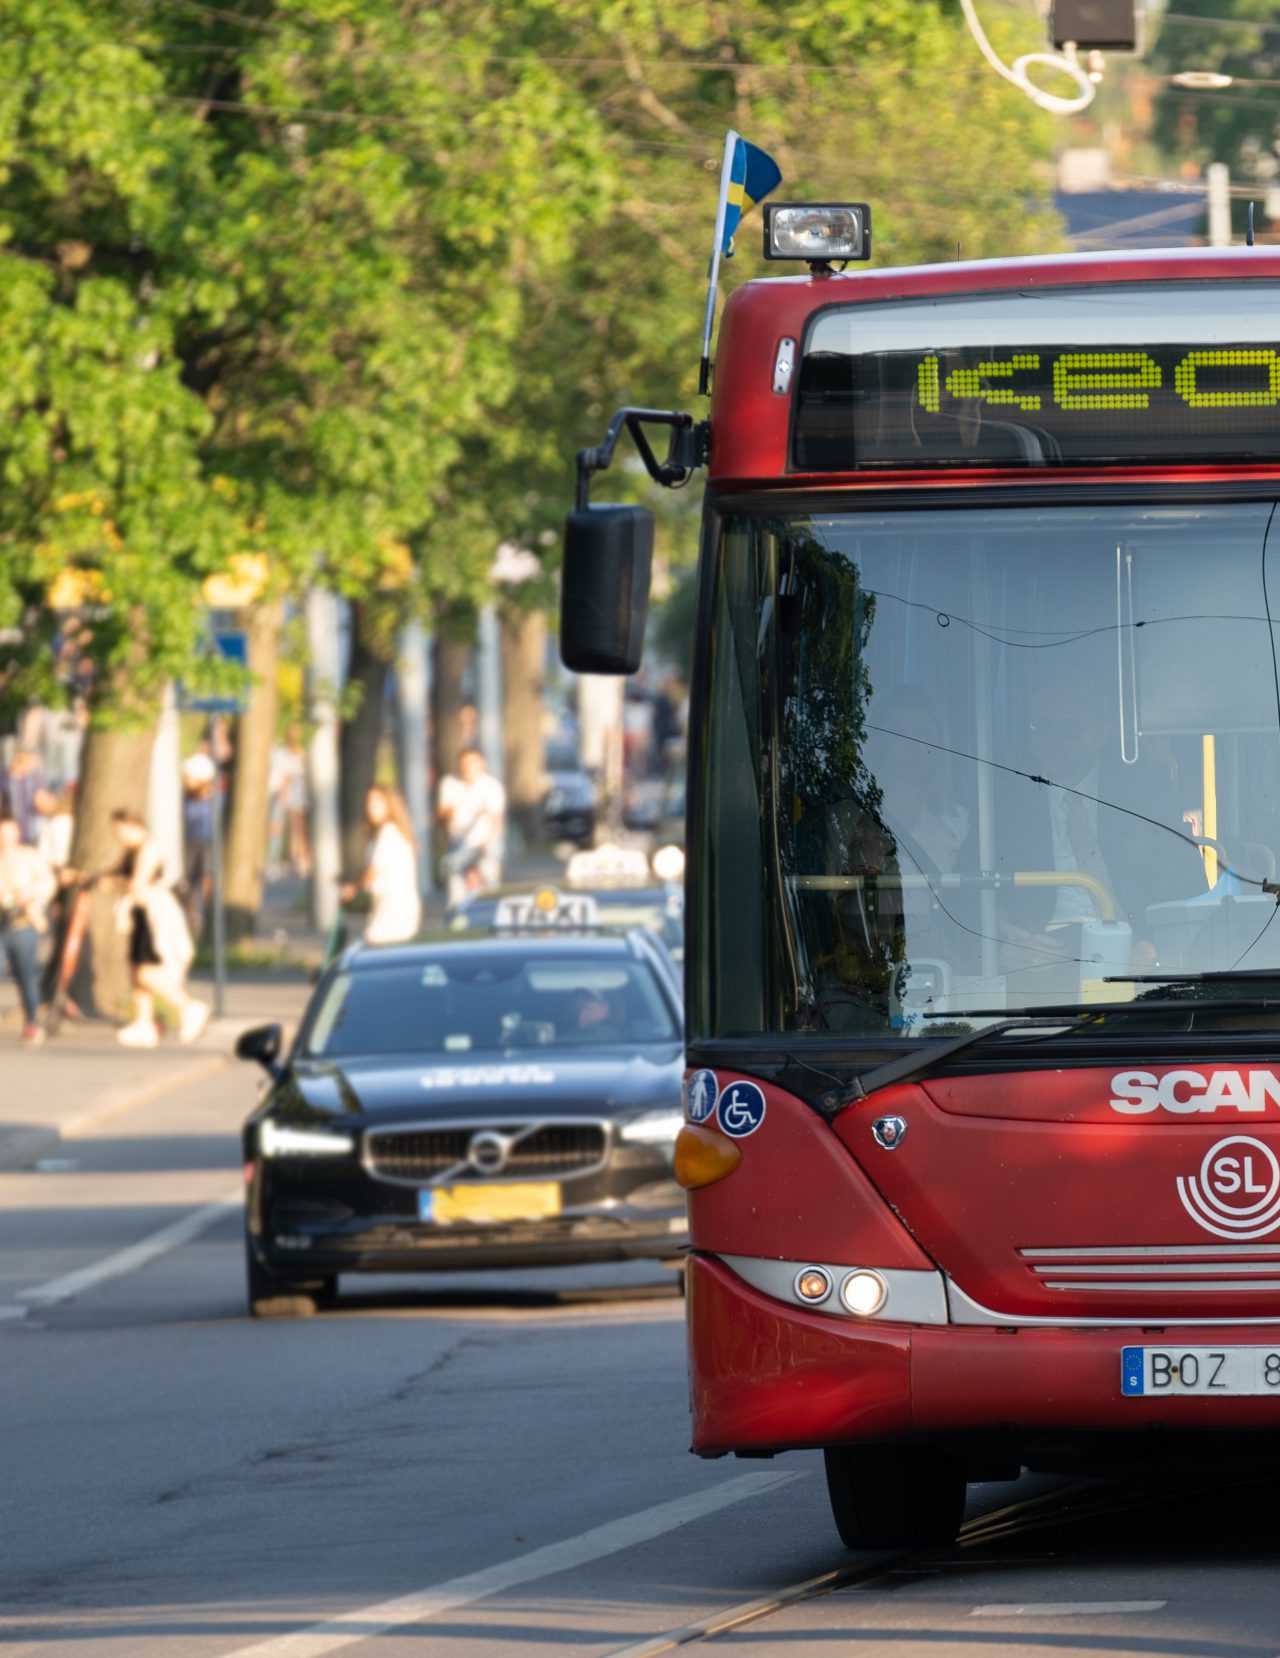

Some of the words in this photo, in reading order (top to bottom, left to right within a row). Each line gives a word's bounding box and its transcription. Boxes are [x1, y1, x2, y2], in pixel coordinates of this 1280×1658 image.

[503, 902, 588, 926] TAXI
[1213, 1156, 1267, 1194] SL
[1129, 1376, 1138, 1386] S
[1151, 1353, 1227, 1388] BOZ
